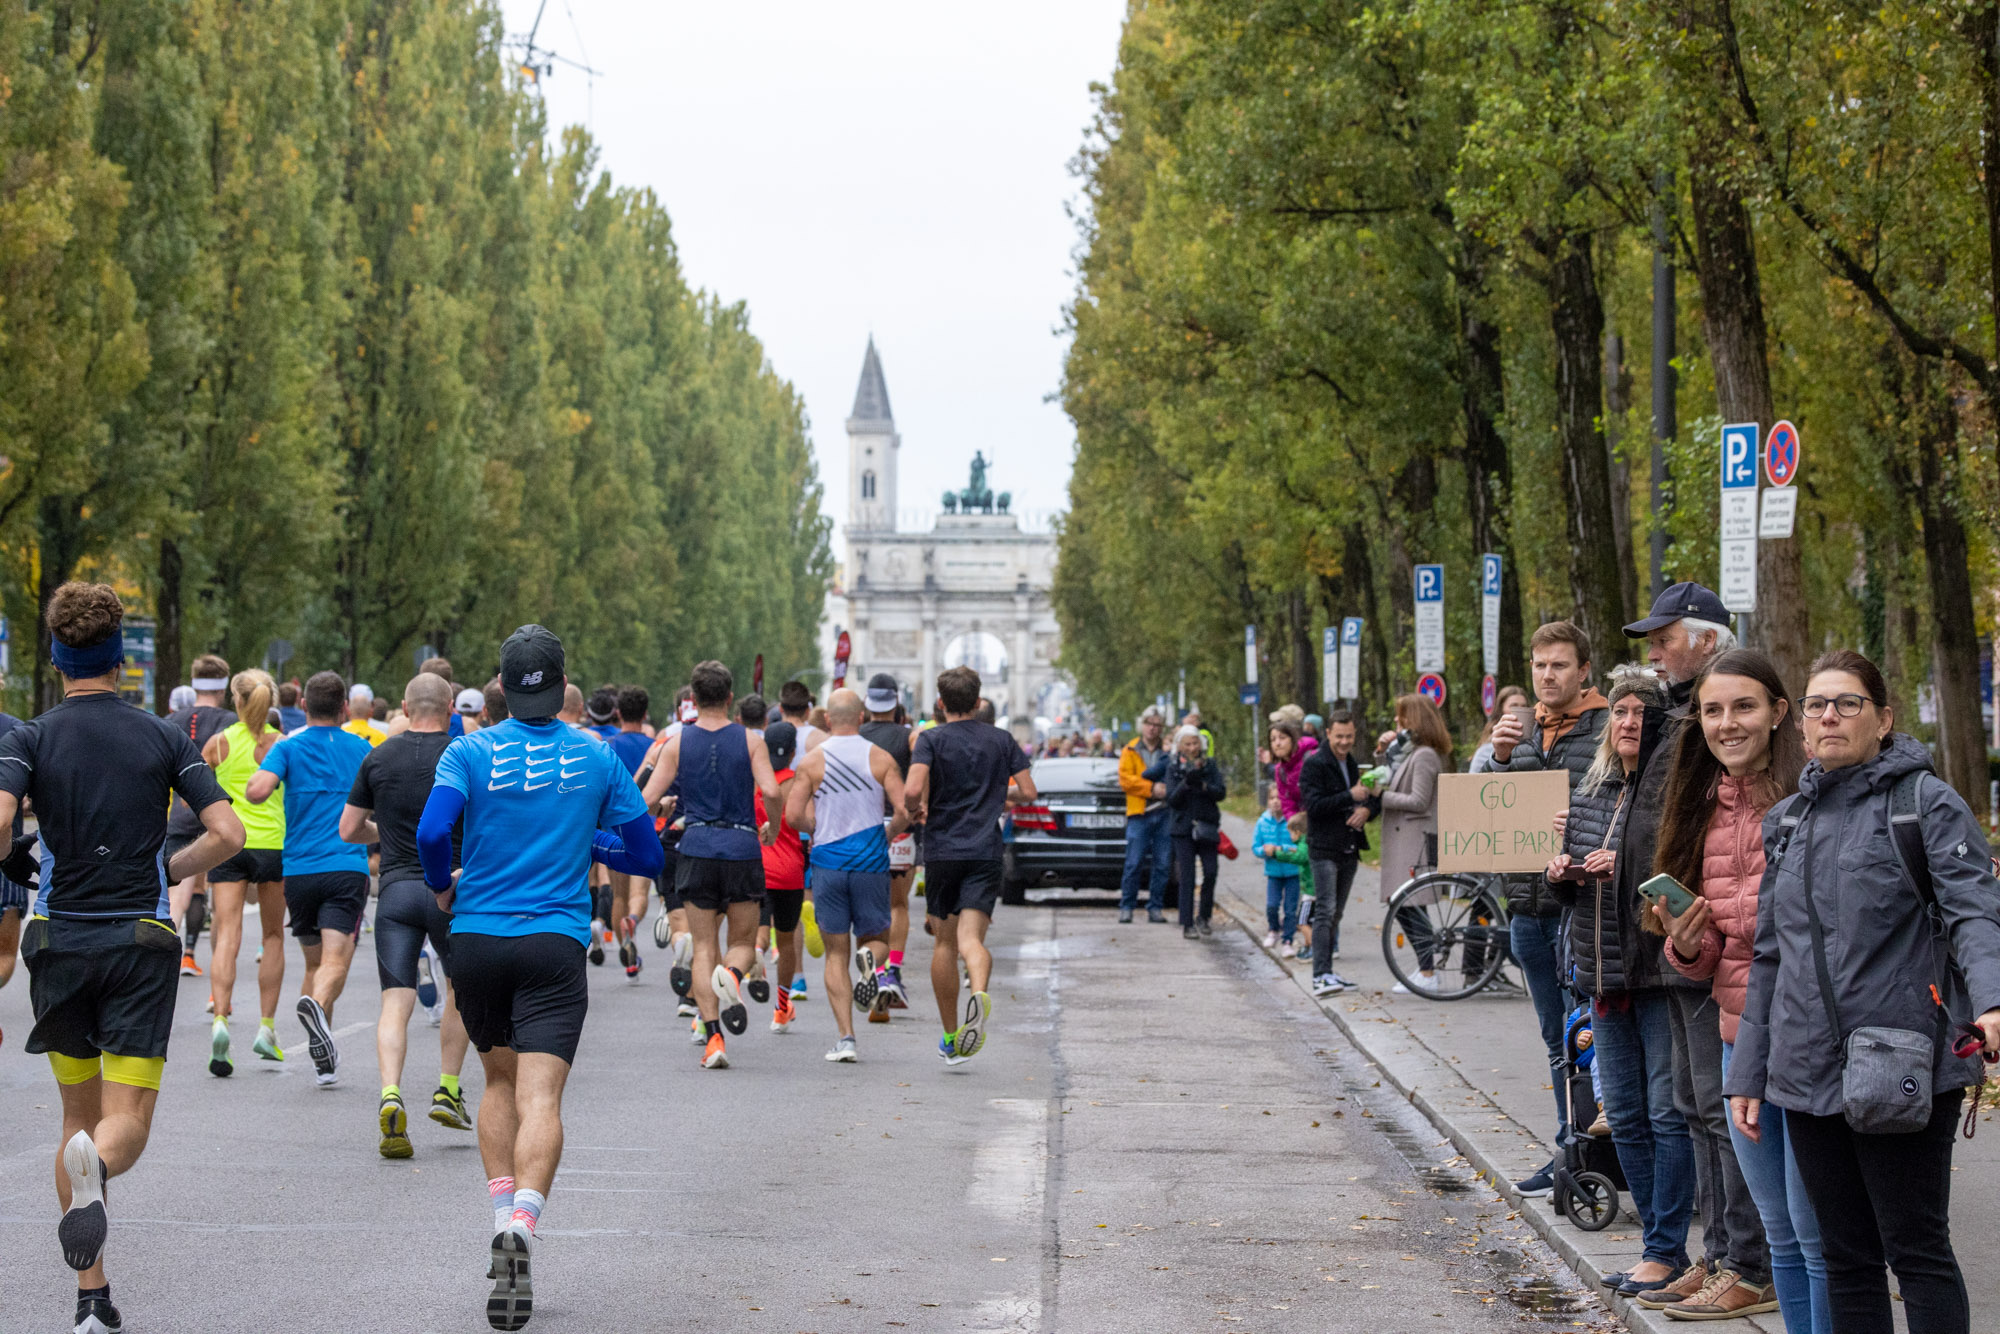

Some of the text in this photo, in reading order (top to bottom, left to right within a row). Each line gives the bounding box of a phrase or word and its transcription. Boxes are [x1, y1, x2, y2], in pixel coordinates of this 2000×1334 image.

[1727, 433, 1748, 482] P
[1419, 570, 1435, 599] P
[1486, 559, 1497, 591] P
[1326, 631, 1335, 650] P
[1345, 621, 1358, 643] P
[520, 670, 544, 686] NB
[1480, 780, 1517, 810] GO
[1444, 830, 1563, 856] HYDE PARK
